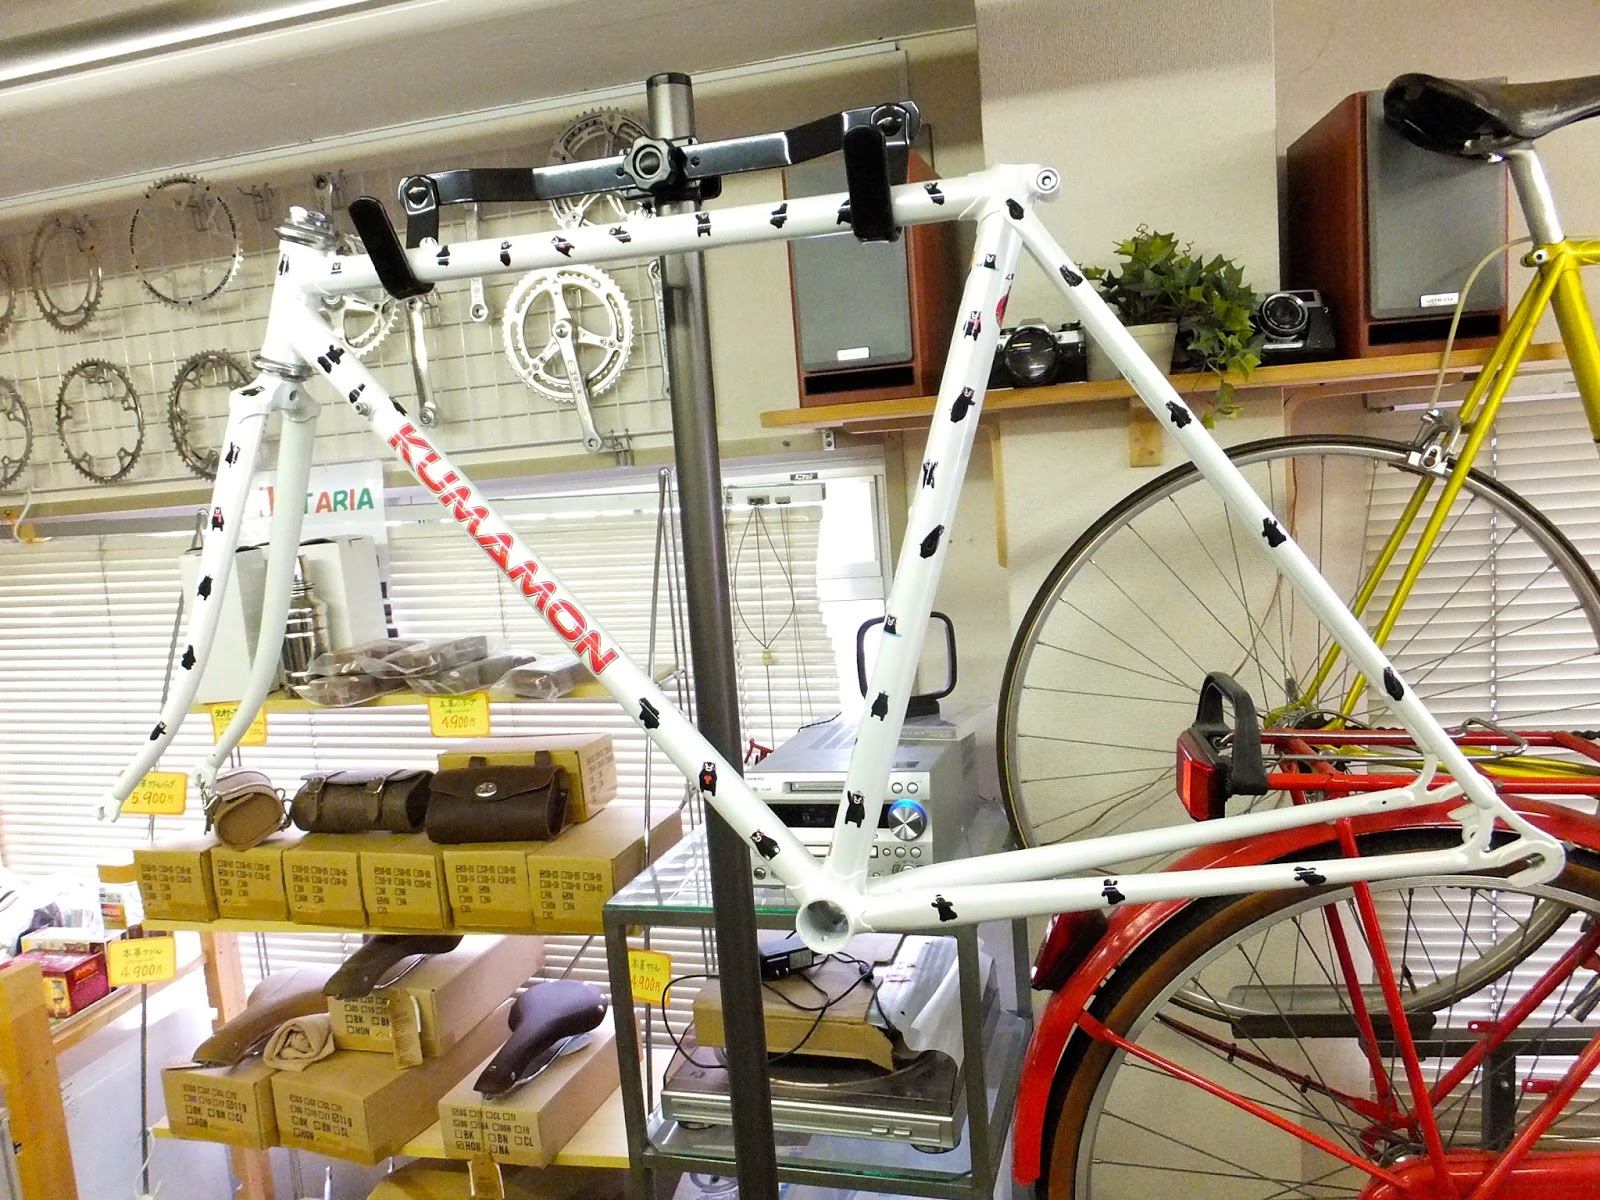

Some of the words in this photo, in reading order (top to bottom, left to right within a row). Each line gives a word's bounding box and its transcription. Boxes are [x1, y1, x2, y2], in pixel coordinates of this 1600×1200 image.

[387, 422, 620, 676] KUMAMON
[464, 1131, 475, 1140] BK
[523, 1136, 535, 1147] CL
